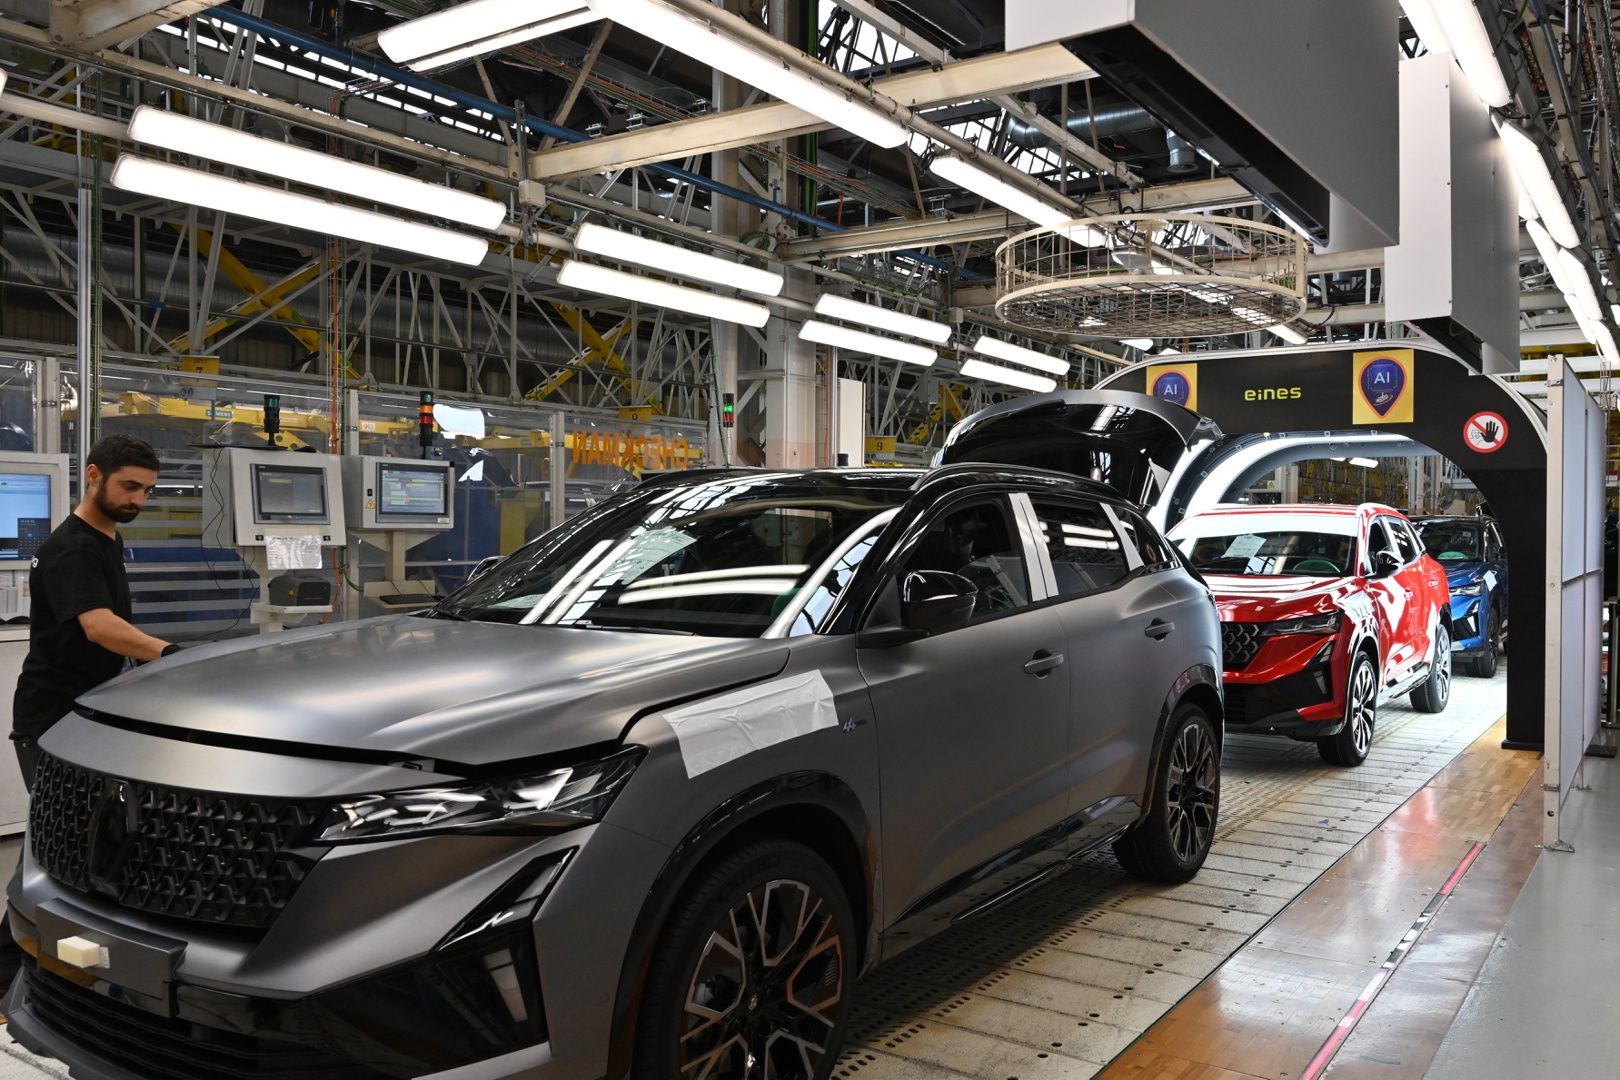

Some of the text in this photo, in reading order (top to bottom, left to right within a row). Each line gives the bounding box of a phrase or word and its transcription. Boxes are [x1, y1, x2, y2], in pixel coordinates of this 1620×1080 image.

[1374, 372, 1391, 384] AI
[1163, 384, 1178, 396] AI
[1244, 387, 1302, 401] eines
[876, 441, 883, 452] 9
